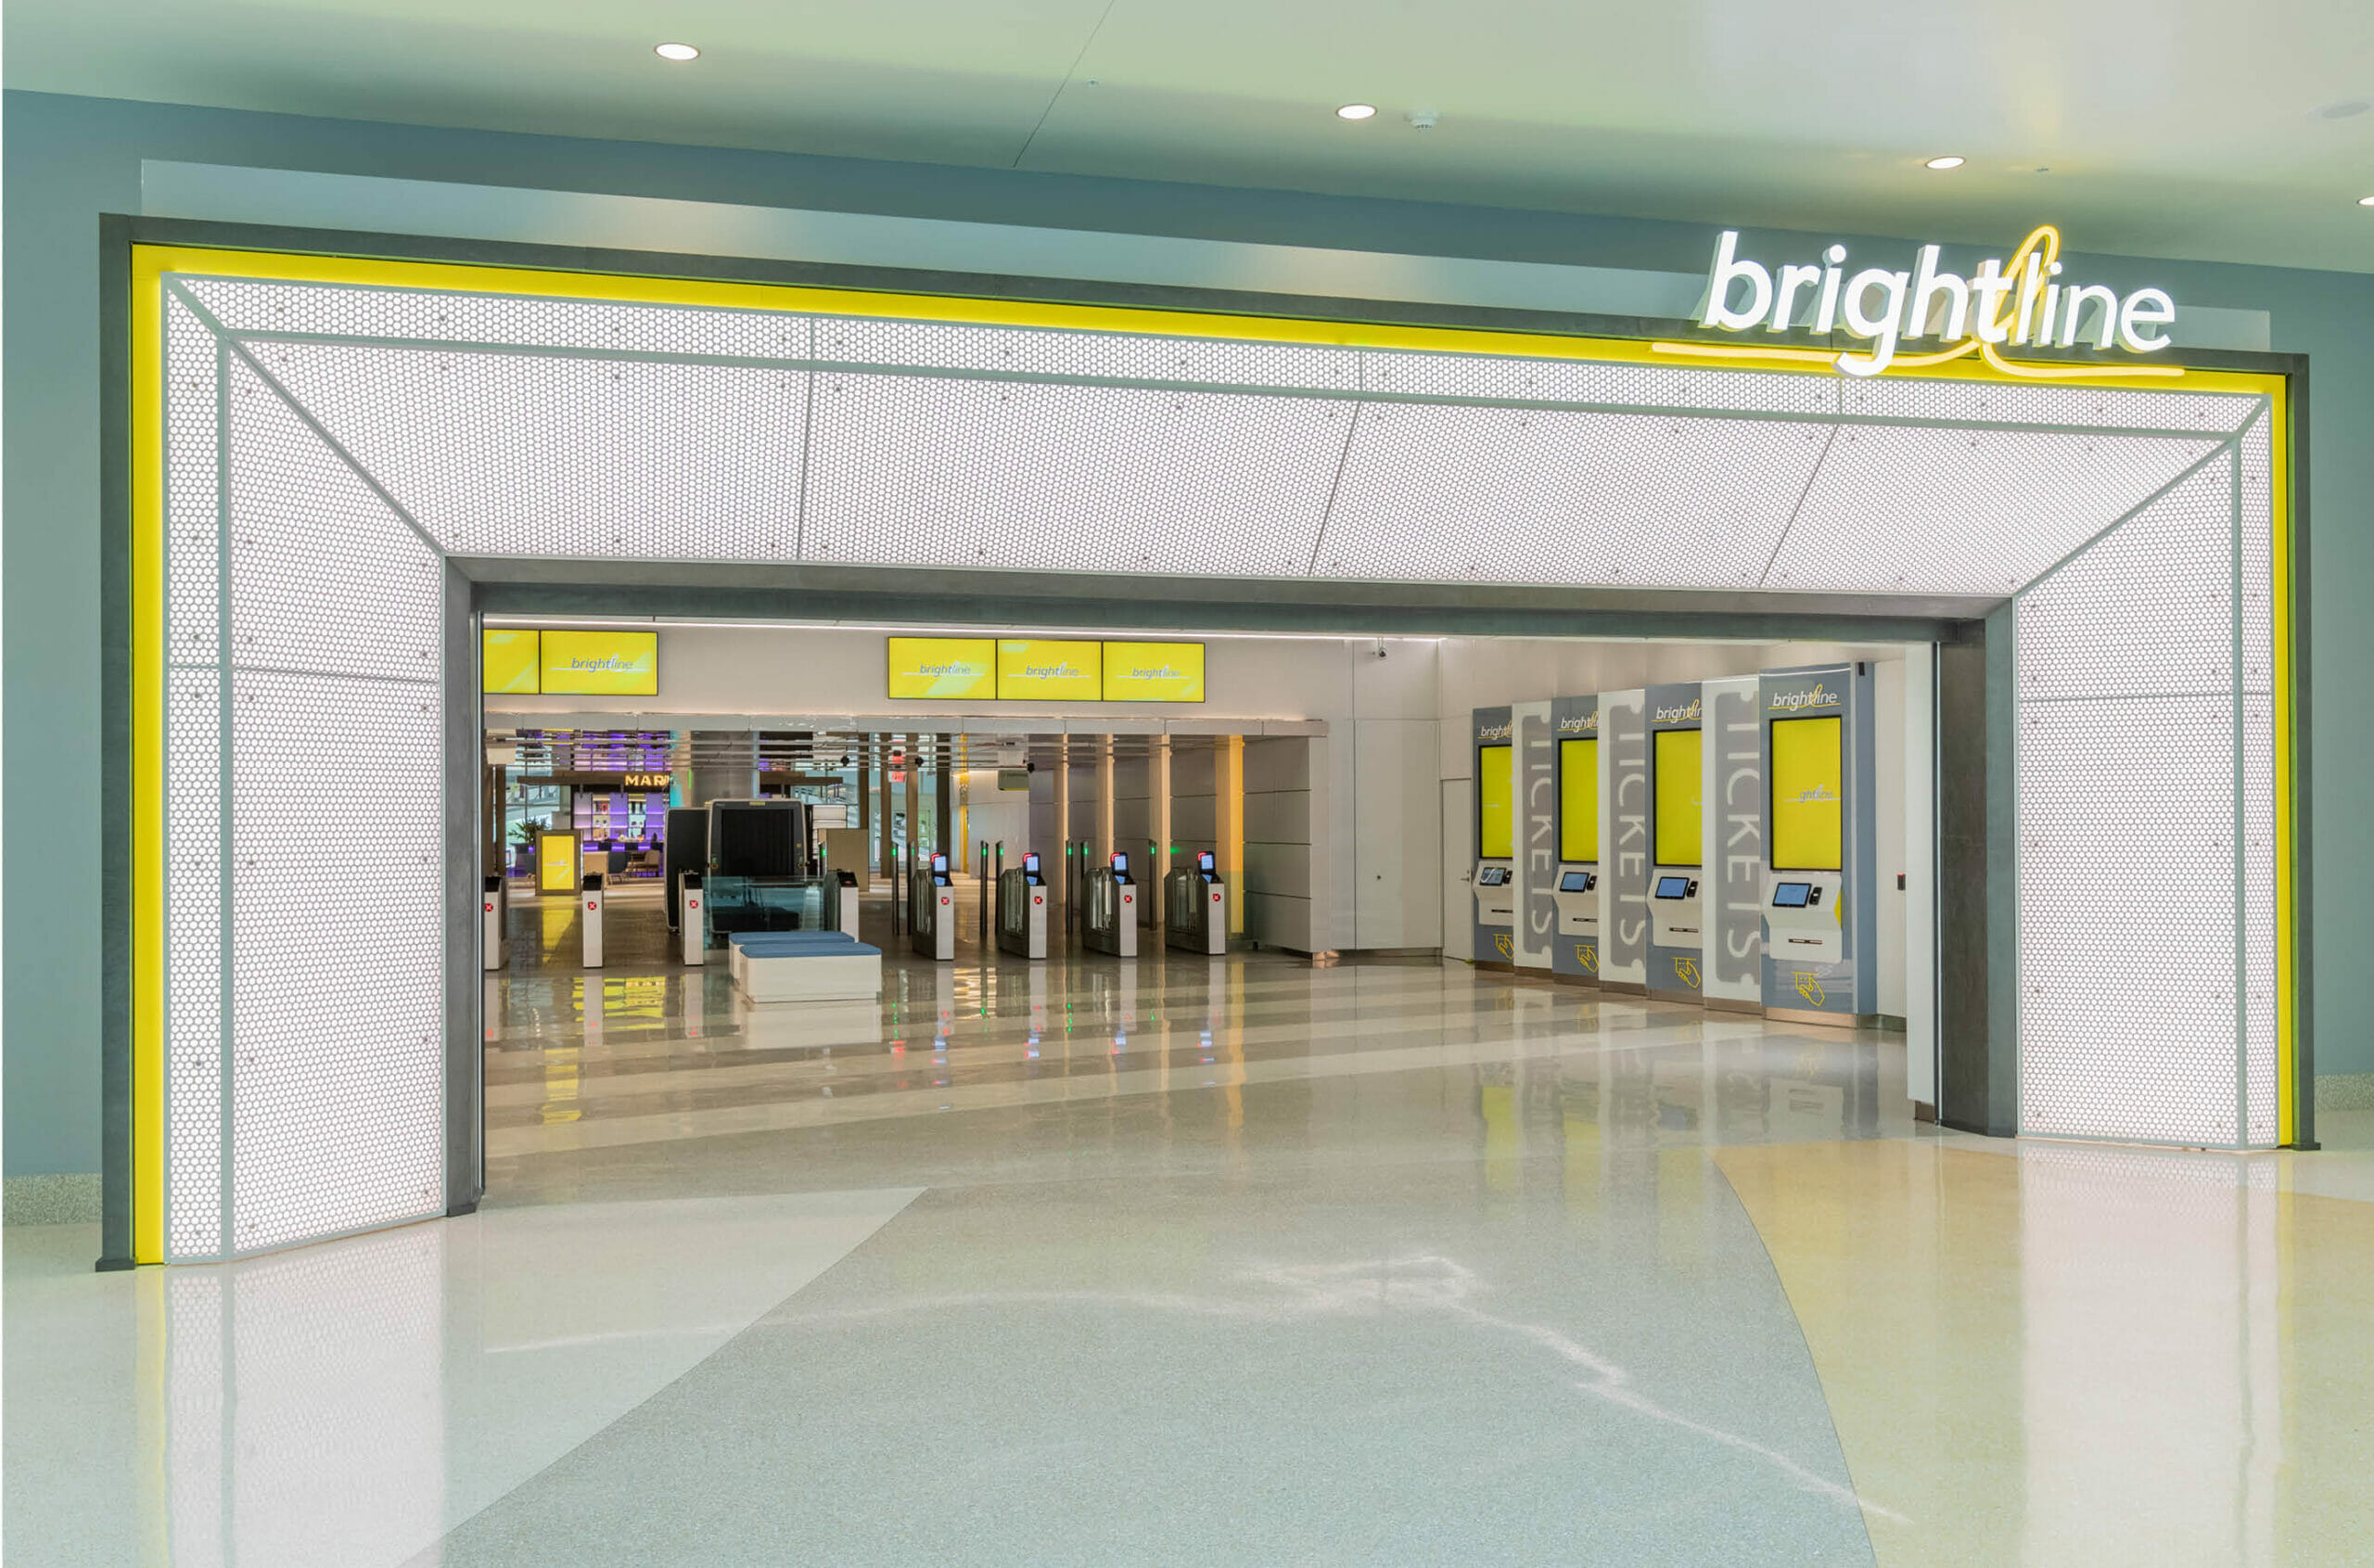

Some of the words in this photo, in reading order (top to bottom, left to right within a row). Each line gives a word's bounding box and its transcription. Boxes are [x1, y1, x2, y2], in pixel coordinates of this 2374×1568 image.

[1703, 225, 2176, 376] brightline
[571, 654, 633, 673] brightline
[919, 661, 971, 678] brightline
[1026, 662, 1079, 679] brightline
[1131, 665, 1180, 681] brightline
[1773, 683, 1838, 711] brightline
[1656, 699, 1703, 723] brightlin
[624, 774, 670, 786] MAR
